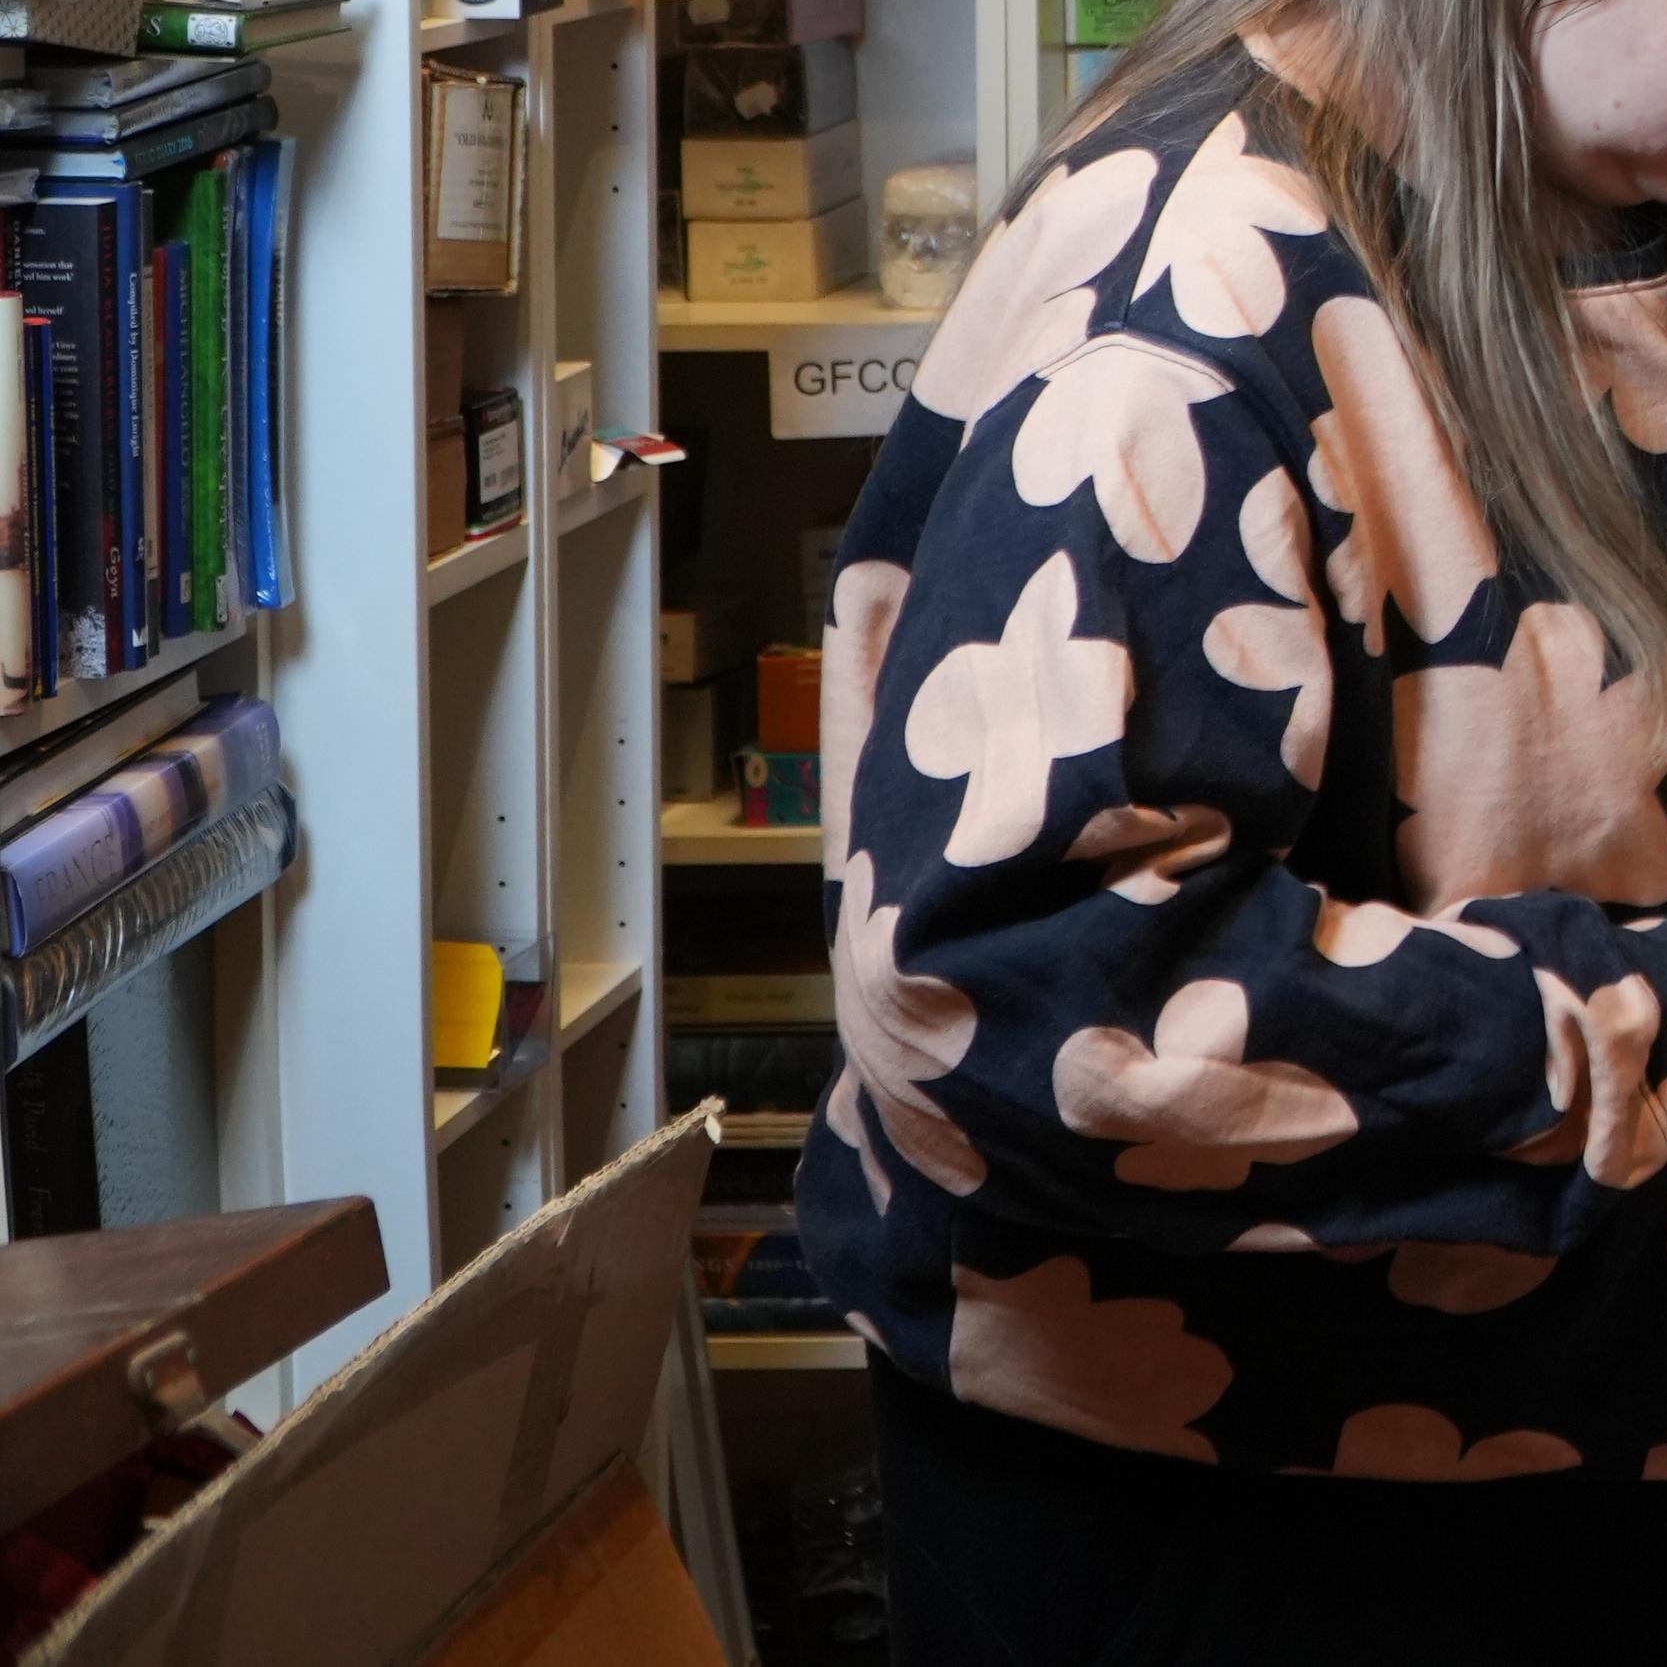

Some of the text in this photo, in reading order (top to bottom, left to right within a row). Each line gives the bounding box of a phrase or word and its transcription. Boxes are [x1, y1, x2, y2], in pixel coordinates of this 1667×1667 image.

[127, 272, 139, 329] Compiled
[127, 332, 139, 346] by
[127, 349, 140, 413] Dominique
[104, 547, 121, 599] Goya
[34, 830, 115, 902] FRANCE
